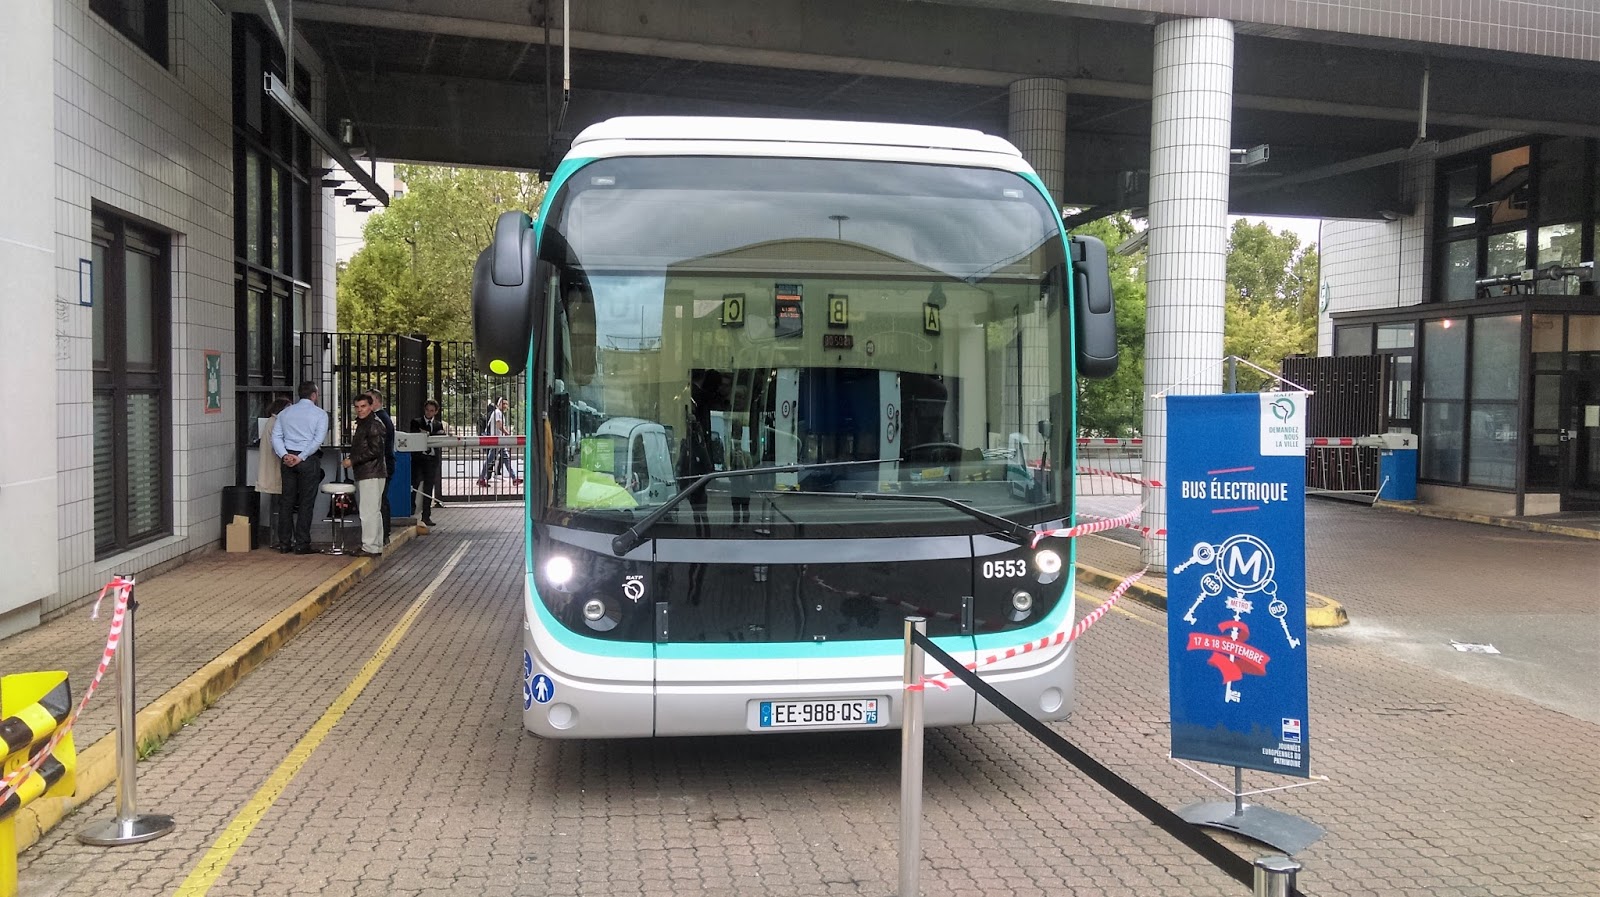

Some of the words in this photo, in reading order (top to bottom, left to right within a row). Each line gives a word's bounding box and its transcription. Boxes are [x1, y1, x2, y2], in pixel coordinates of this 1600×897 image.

[1182, 480, 1207, 500] BUS
[1210, 477, 1288, 504] ÉLECTRIQUE
[983, 559, 1027, 579] 0553
[1228, 545, 1263, 583] M
[1203, 576, 1220, 592] RER
[1271, 604, 1286, 615] BUS
[1194, 636, 1202, 646] 17
[1204, 638, 1210, 647] &
[1212, 638, 1220, 649] 18
[1221, 640, 1265, 665] SEPTEMBRE
[866, 711, 876, 721] 75
